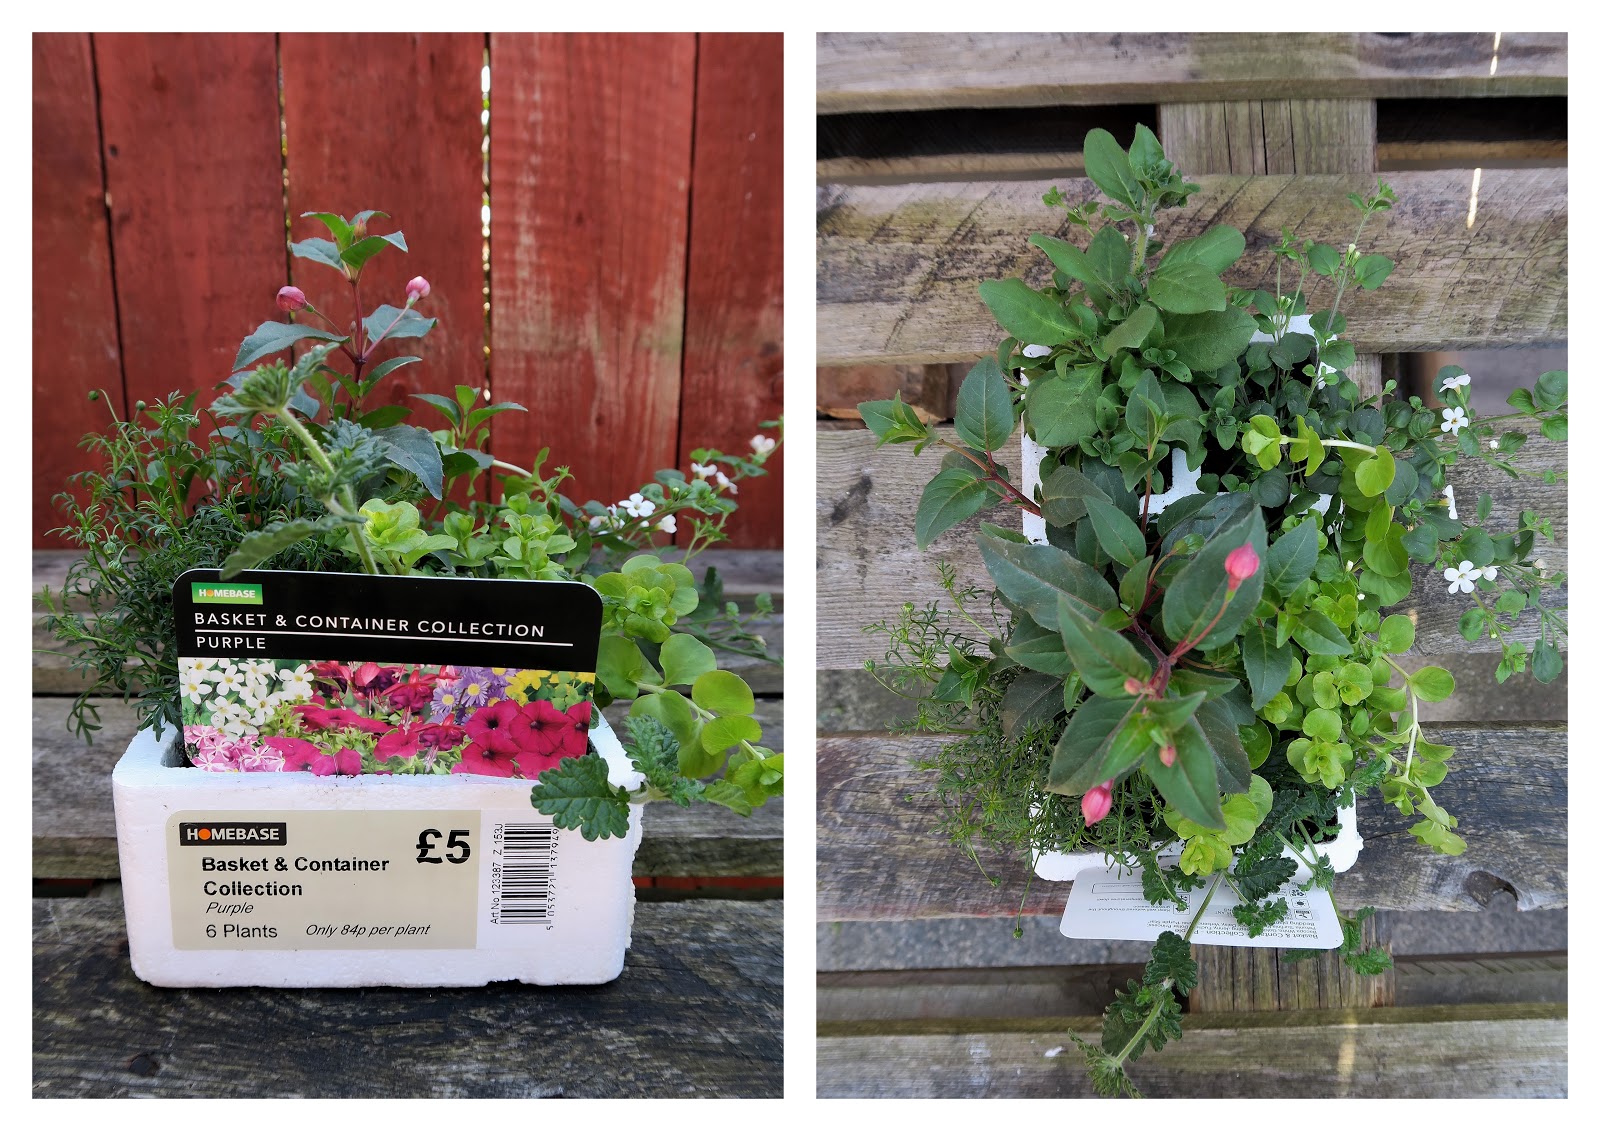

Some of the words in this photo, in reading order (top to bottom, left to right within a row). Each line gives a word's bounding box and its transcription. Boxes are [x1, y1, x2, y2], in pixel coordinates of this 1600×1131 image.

[198, 588, 256, 598] HOMEBASE
[194, 612, 268, 626] BASKET
[275, 614, 288, 627] &
[295, 615, 410, 632] CONTAINER
[417, 620, 544, 638] COLLECTION
[196, 636, 266, 650] PURPLE
[186, 828, 280, 841] HOMEBASE
[416, 828, 471, 864] £5
[550, 828, 560, 868] 137949
[202, 856, 270, 872] Basket
[274, 857, 289, 872] &
[294, 856, 390, 872] Container
[492, 862, 502, 894] 123387
[203, 881, 303, 897] Collection
[205, 902, 254, 915] Purple
[490, 898, 500, 910] No
[490, 912, 500, 924] Art
[206, 924, 217, 938] 6
[223, 924, 278, 938] Plants
[306, 924, 338, 938] Only
[340, 924, 366, 938] 84p
[368, 926, 392, 938] per
[394, 924, 431, 938] plant
